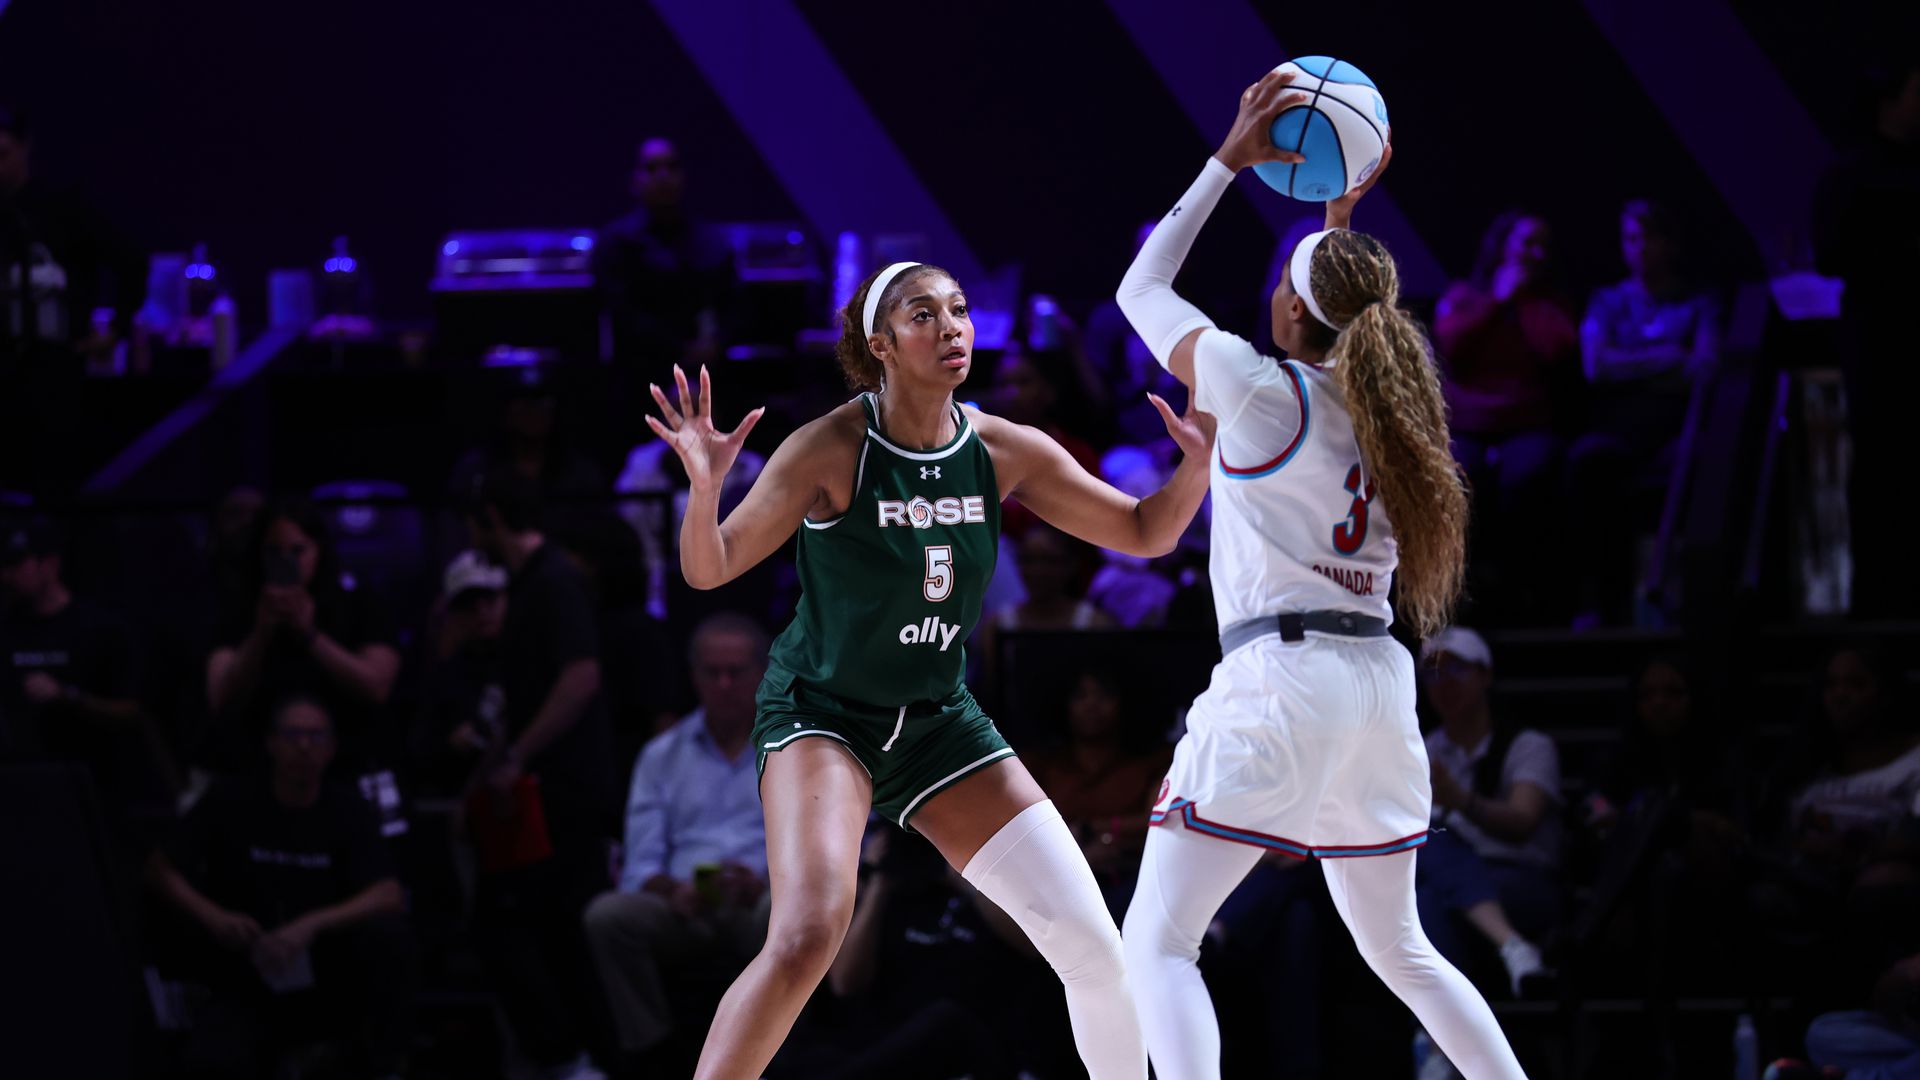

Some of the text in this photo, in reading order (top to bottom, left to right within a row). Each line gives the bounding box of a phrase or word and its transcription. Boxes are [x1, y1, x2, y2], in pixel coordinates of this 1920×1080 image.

[878, 495, 986, 529] ROSE
[1333, 462, 1377, 557] 3
[923, 545, 954, 602] 5
[899, 616, 961, 651] ally
